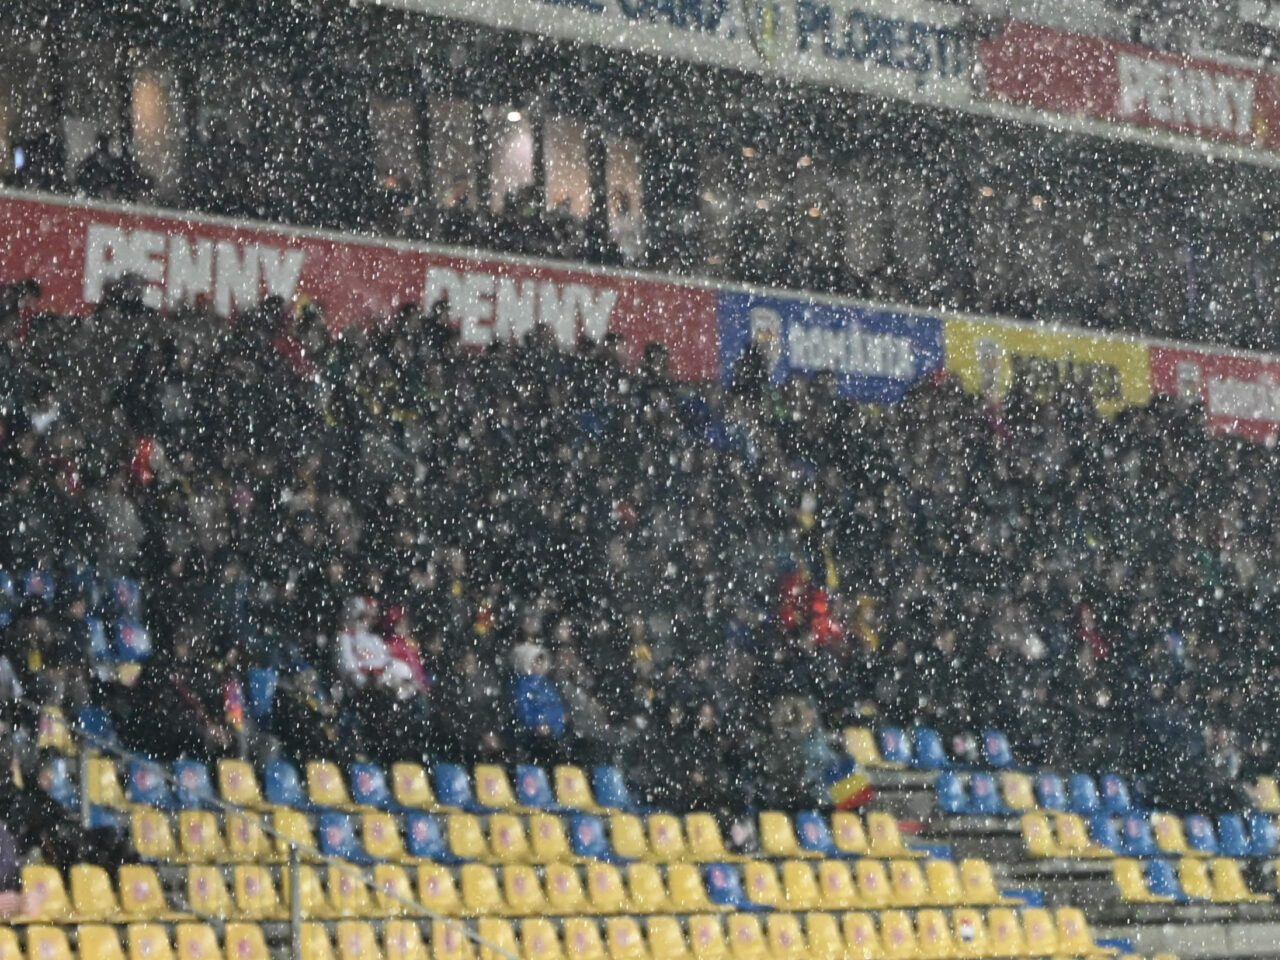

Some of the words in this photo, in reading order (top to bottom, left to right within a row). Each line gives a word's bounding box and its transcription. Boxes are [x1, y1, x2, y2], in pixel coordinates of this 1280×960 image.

[1116, 50, 1255, 136] PENNY
[83, 222, 304, 318] PENNY
[422, 264, 619, 350] PENNY
